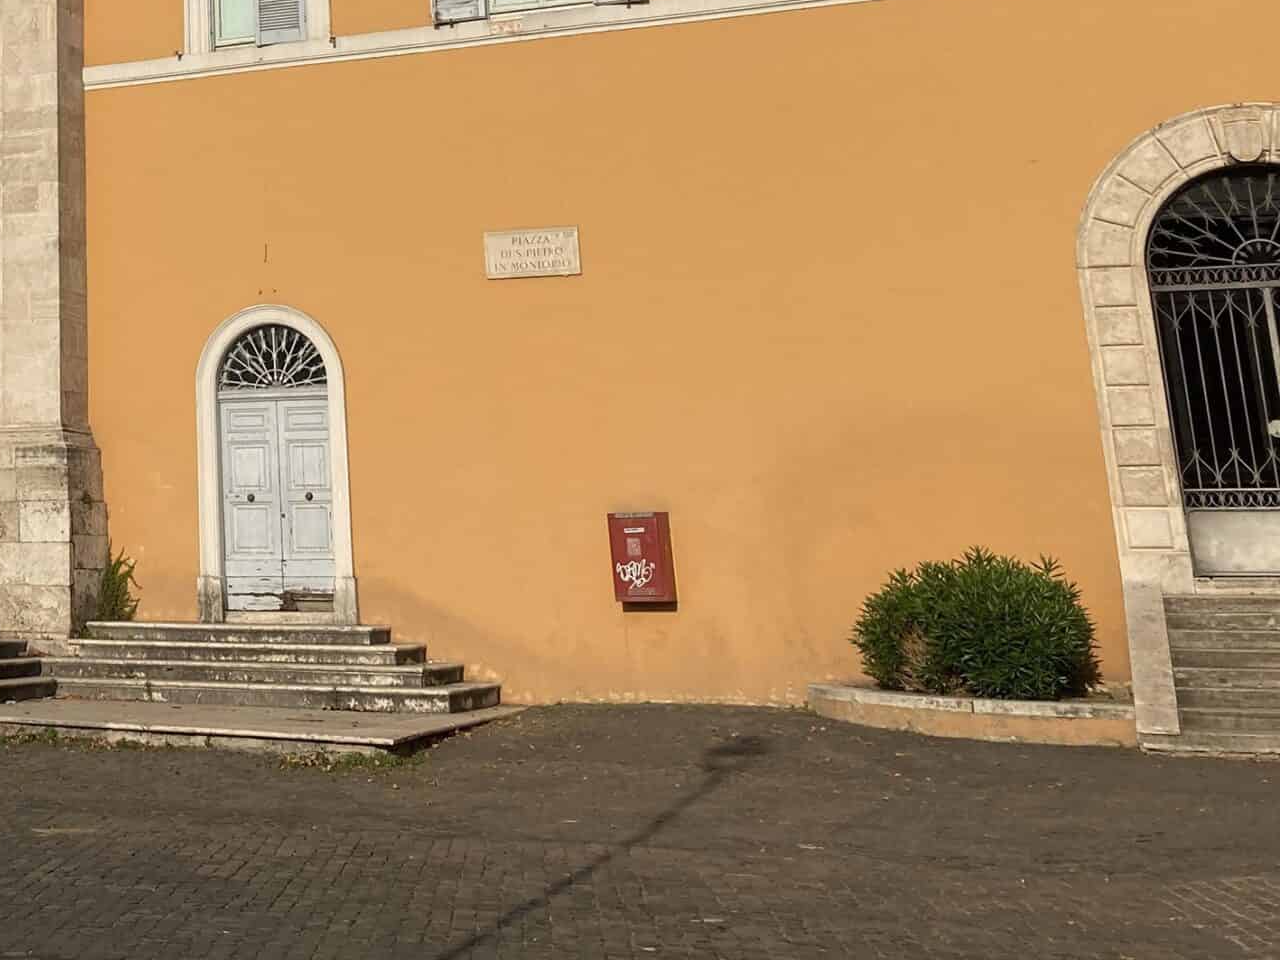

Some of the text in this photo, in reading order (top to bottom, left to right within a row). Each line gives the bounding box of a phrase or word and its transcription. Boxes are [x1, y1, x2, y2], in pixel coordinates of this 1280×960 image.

[511, 234, 551, 246] PIAZZA
[526, 246, 565, 257] PIETRO
[494, 262, 507, 272] IN
